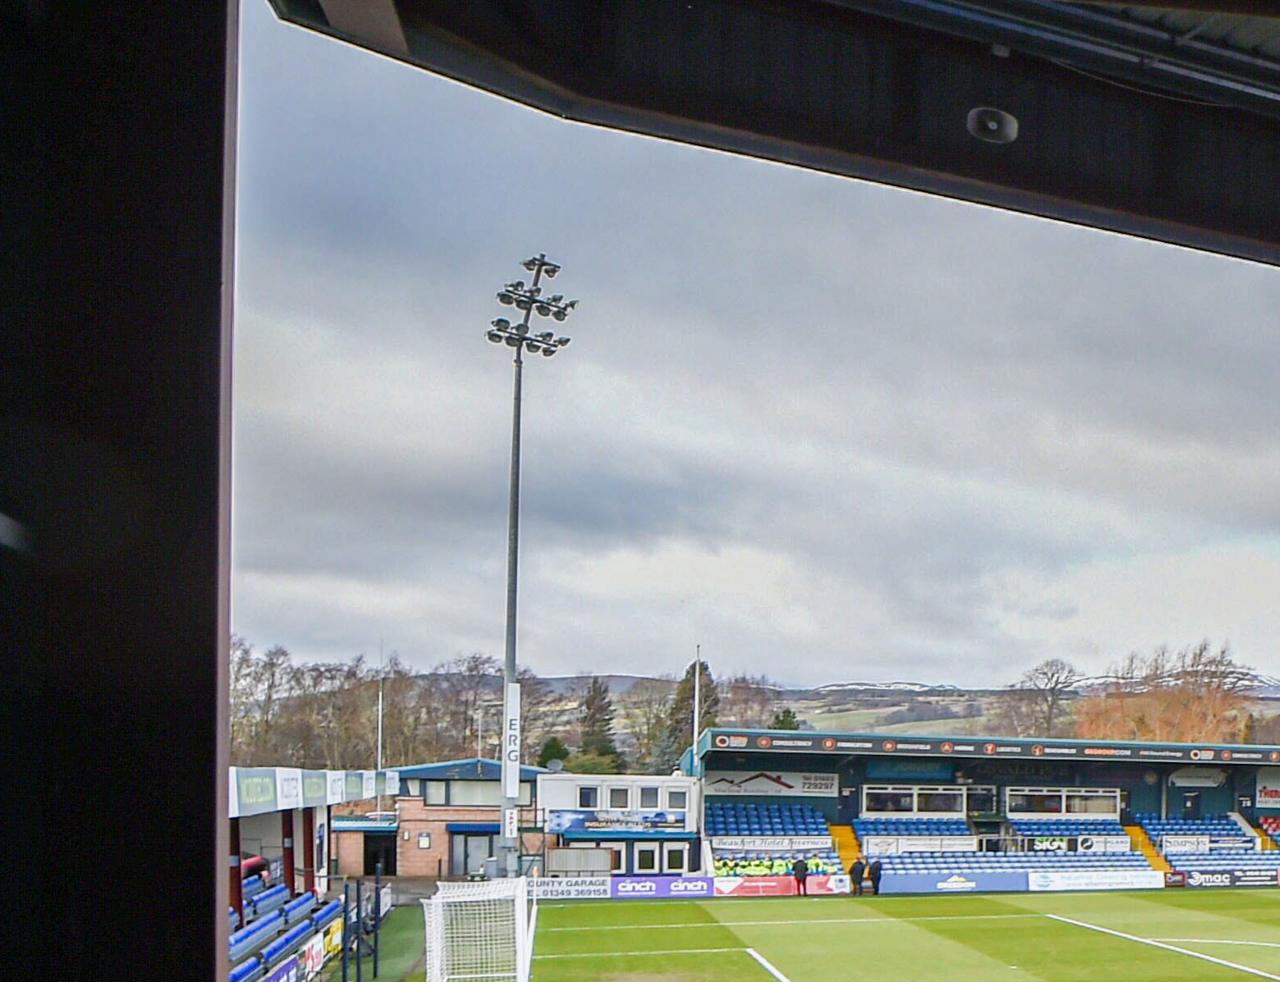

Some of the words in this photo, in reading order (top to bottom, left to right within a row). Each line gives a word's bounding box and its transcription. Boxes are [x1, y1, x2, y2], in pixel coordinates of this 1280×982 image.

[760, 837, 786, 847] Hotel
[527, 879, 563, 888] OUNTY
[566, 879, 608, 887] GARAGE
[618, 879, 656, 892] cinch
[670, 879, 707, 891] cinch
[574, 888, 608, 897] 369158
